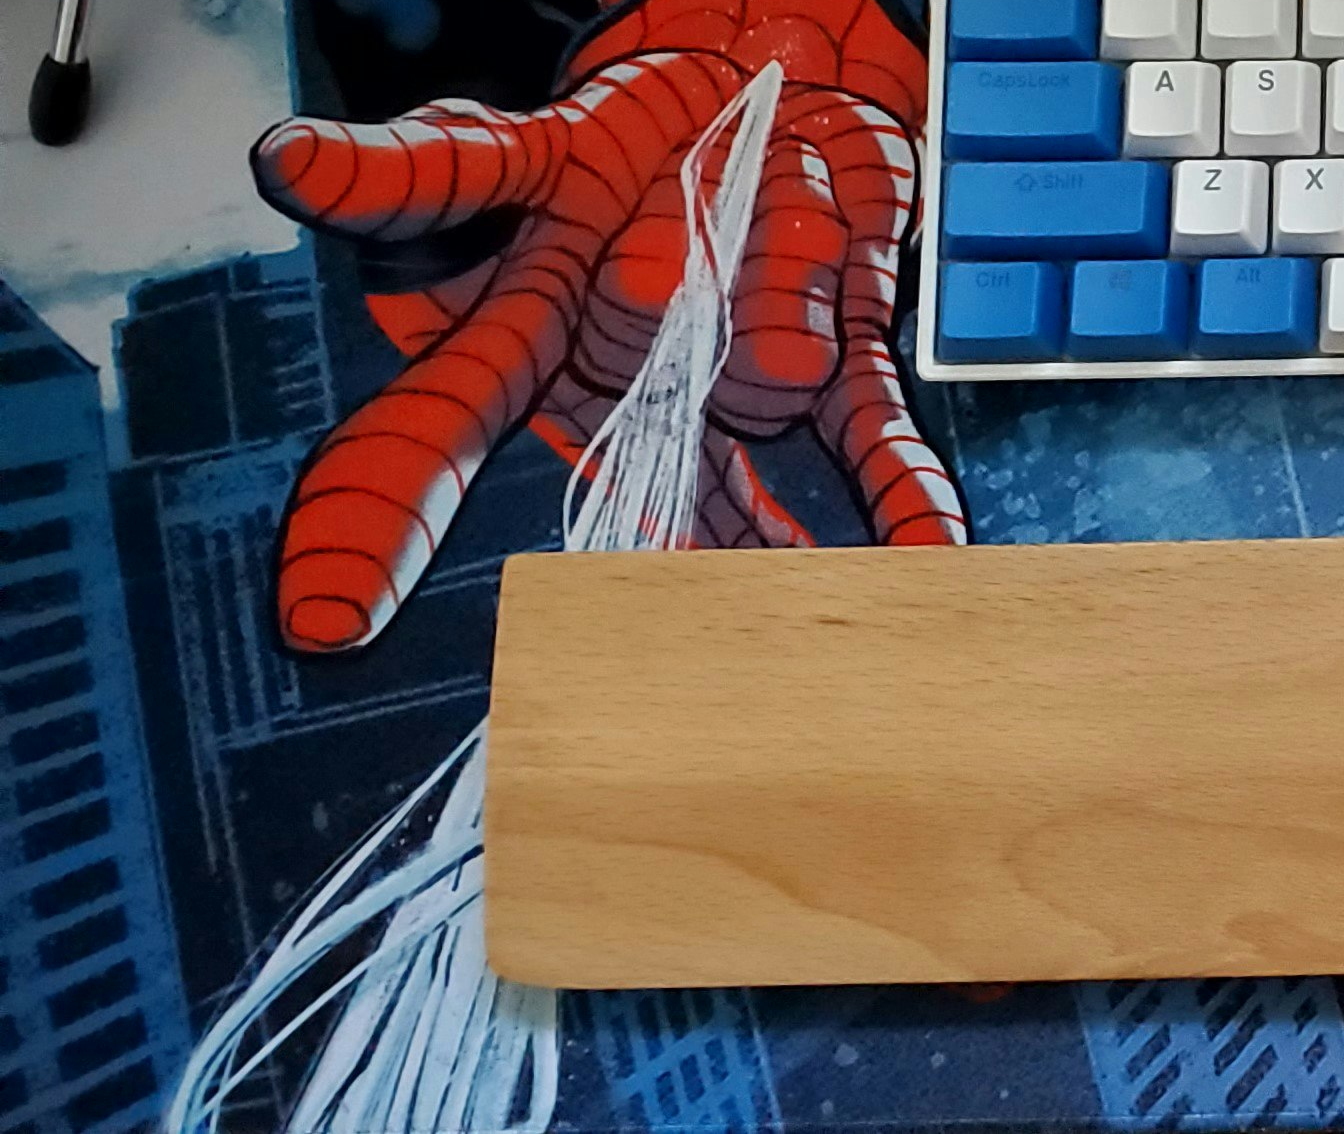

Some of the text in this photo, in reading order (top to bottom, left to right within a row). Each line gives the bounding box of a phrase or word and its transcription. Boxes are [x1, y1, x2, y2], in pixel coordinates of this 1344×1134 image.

[978, 71, 1071, 91] CapsLock
[1154, 70, 1175, 92] A
[1257, 69, 1275, 92] S
[1203, 168, 1223, 191] Z
[1304, 167, 1325, 191] X
